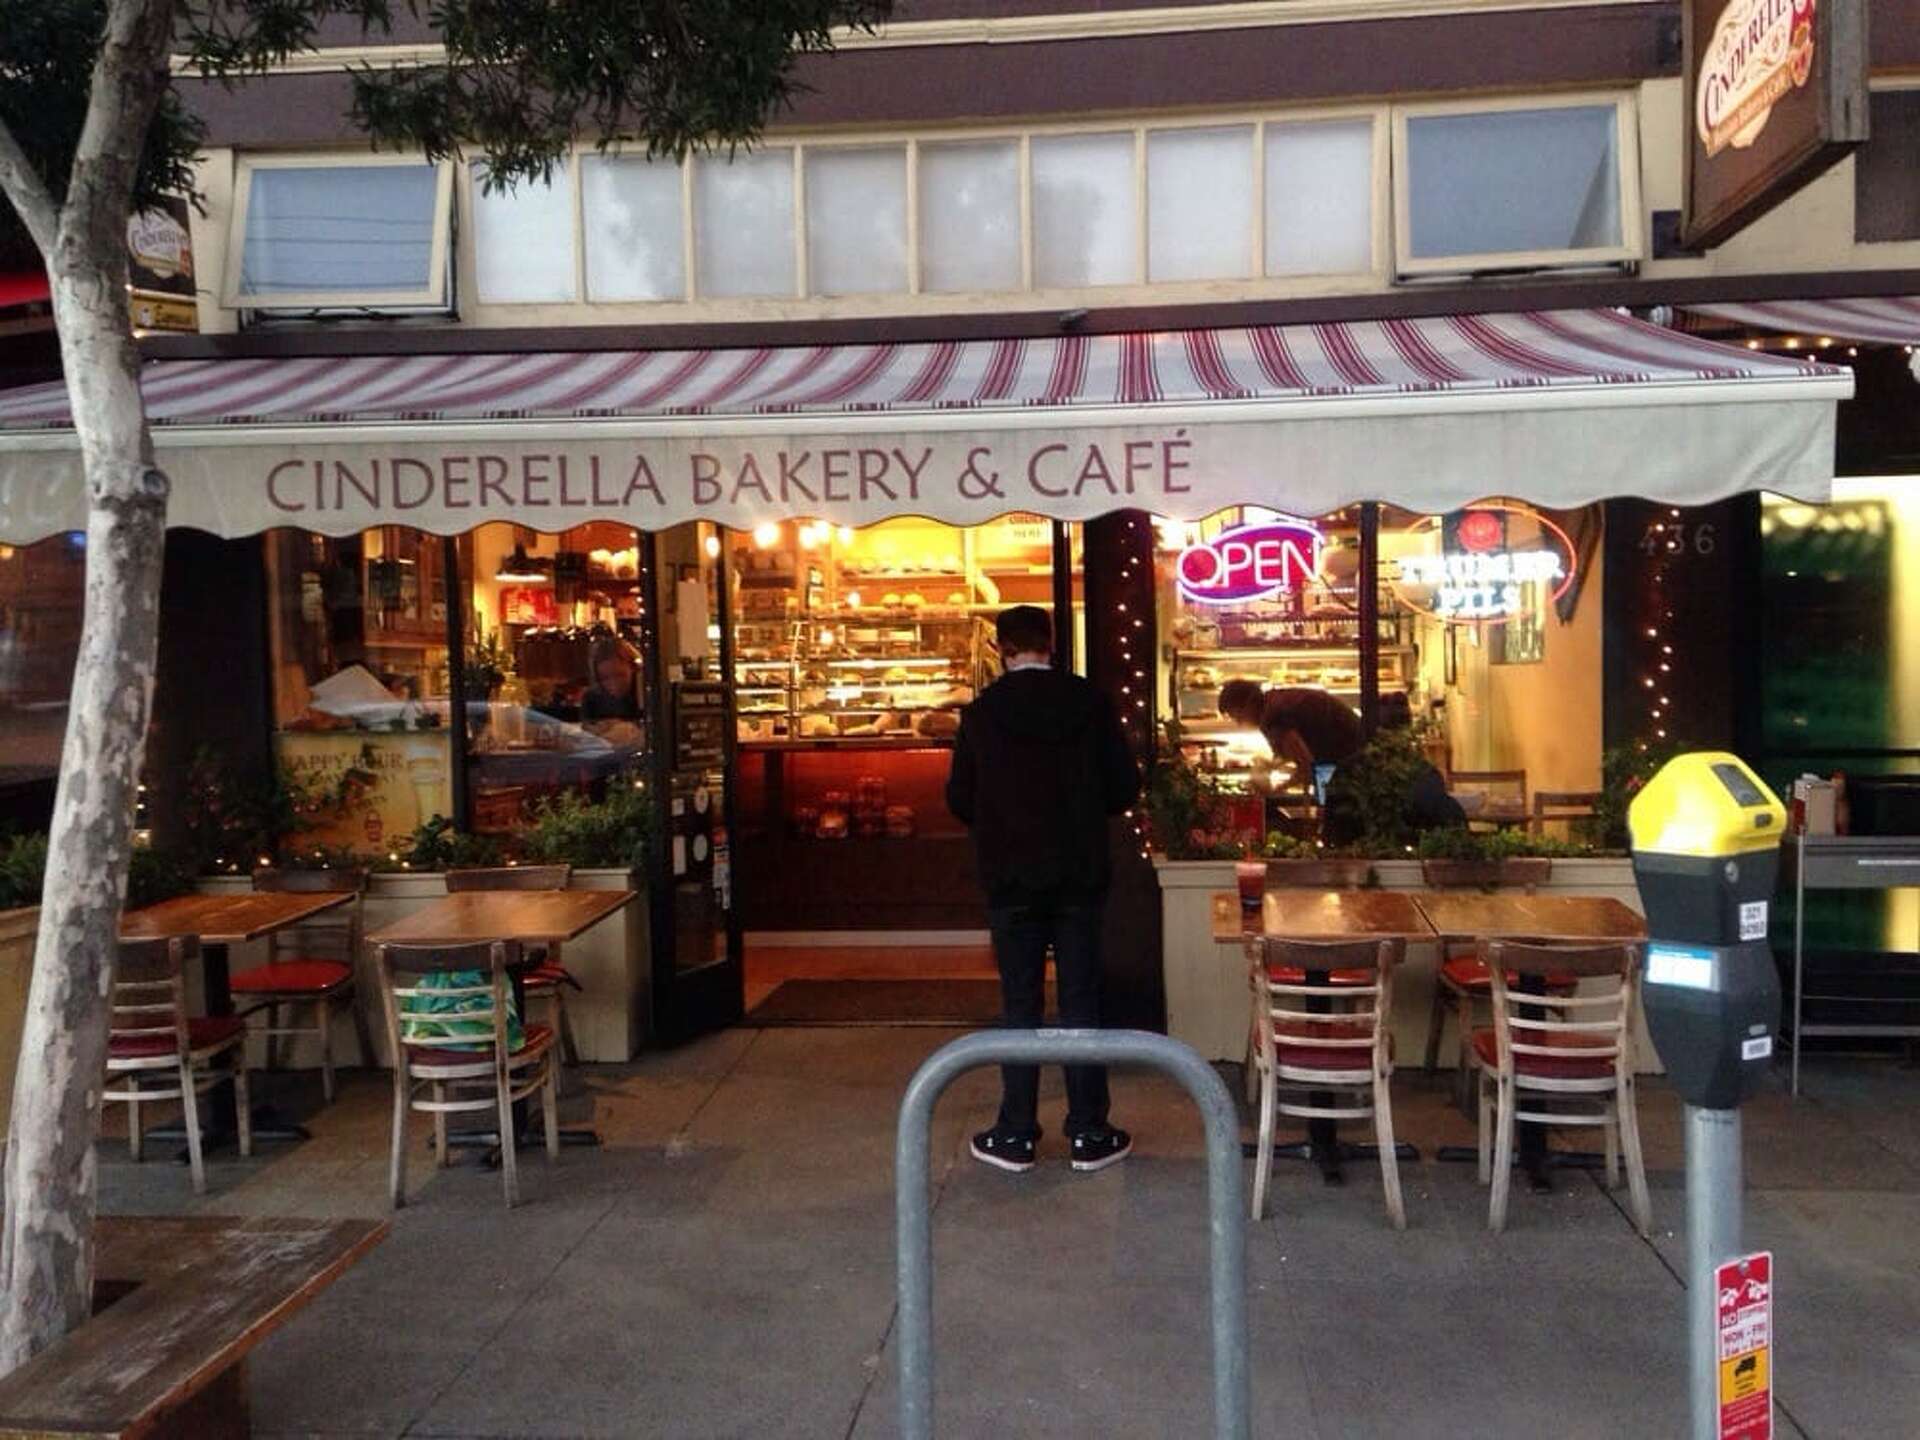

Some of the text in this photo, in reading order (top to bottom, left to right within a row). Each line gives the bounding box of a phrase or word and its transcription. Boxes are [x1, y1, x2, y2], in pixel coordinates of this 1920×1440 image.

[265, 427, 1192, 512] CINDERELLA BAKERY & CAFÉ
[1177, 536, 1321, 589] OPEN
